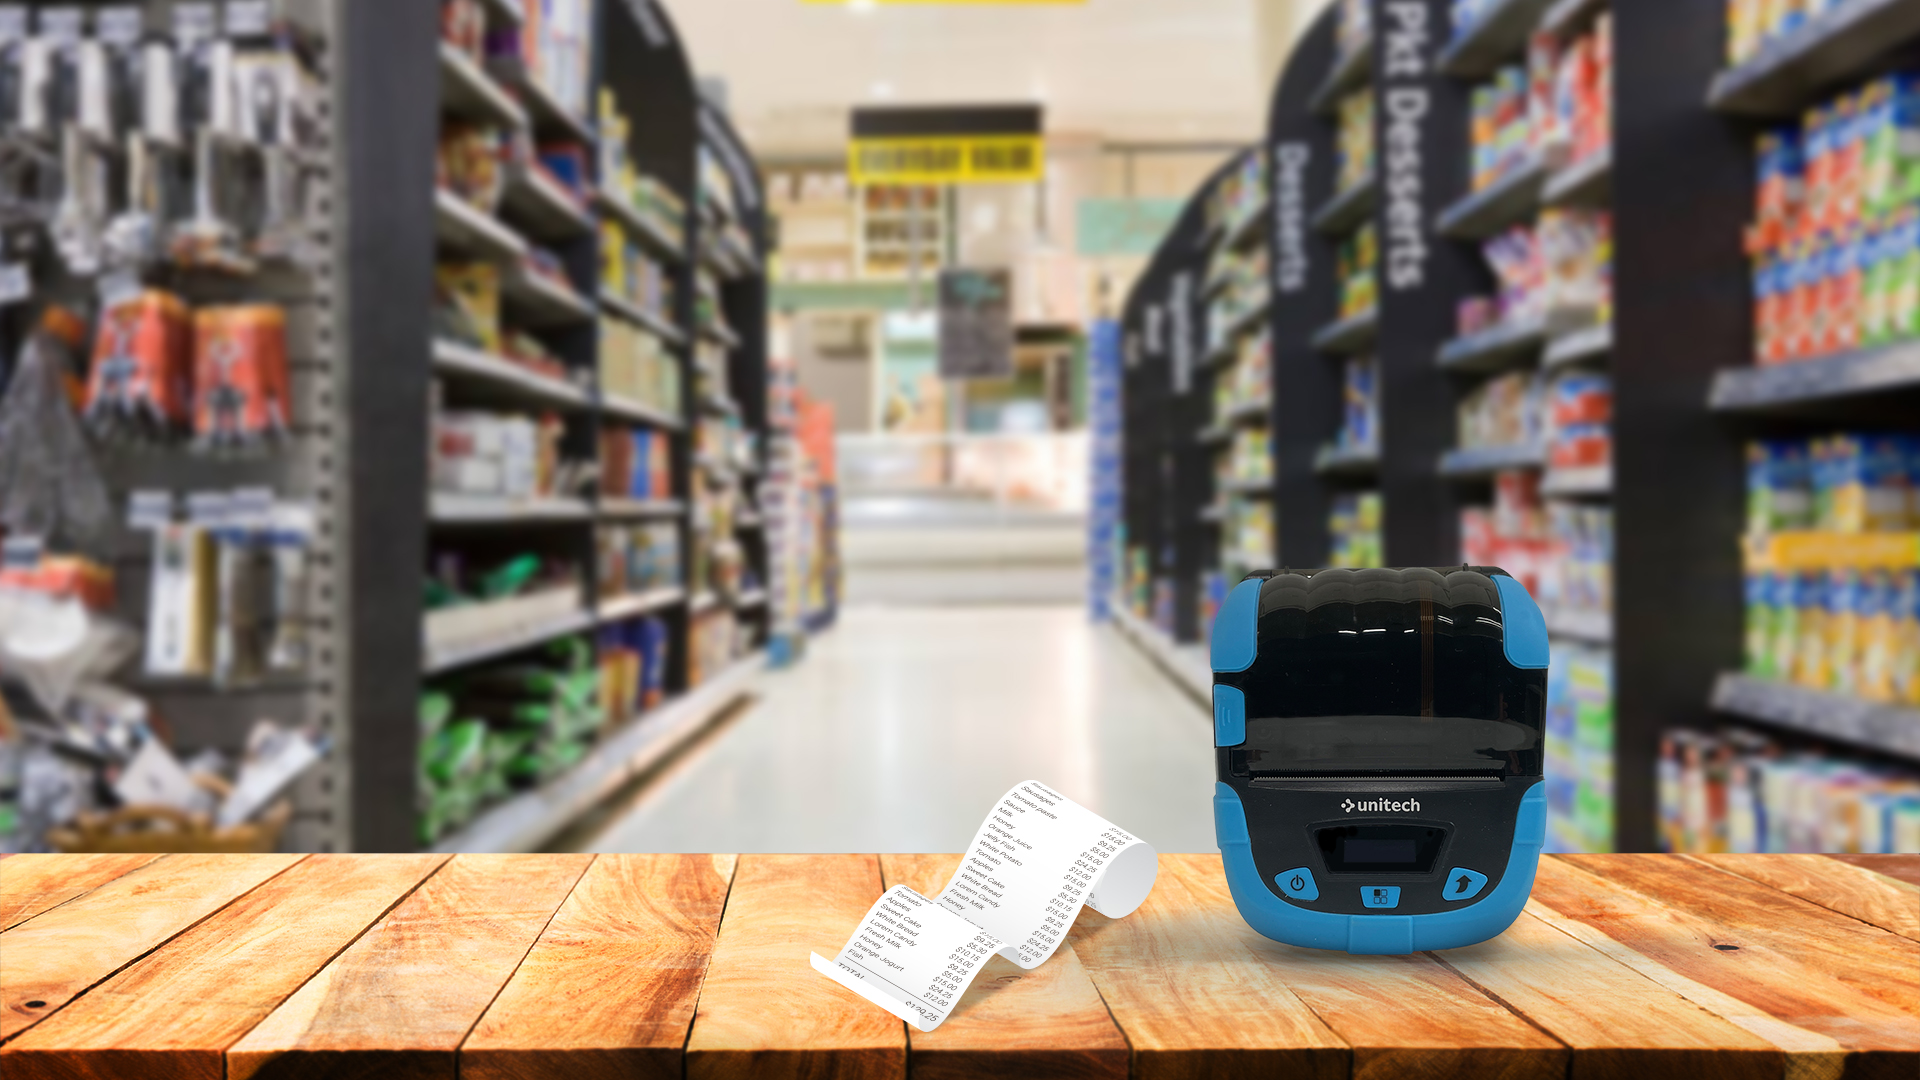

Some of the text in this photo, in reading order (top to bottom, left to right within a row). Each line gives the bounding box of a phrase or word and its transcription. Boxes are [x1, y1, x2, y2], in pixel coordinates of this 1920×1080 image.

[1385, 2, 1430, 289] Pkt Desserts
[1277, 141, 1310, 291] Desserts
[1011, 791, 1037, 809] Tomato
[1098, 840, 1117, 852] $9.25
[1021, 785, 1055, 806] Sausages
[1358, 797, 1420, 812] unitech
[988, 823, 1092, 880] Orange Juice $12.00
[993, 815, 1097, 873] Honey $24.25
[998, 807, 1103, 865] Milk $15.00
[1003, 800, 1109, 858] Sauce $5.00
[969, 857, 993, 872] Apples
[1050, 898, 1073, 912] $10.15
[975, 848, 1001, 865] Tomato
[1058, 892, 1077, 903] $5.30
[980, 840, 1082, 896] White Potato $9.25
[983, 832, 1086, 888] Jelly Fish $15.00
[894, 889, 996, 949] Tomato $9.25
[949, 888, 1055, 944] Fresh Milk $15.00
[955, 881, 1060, 936] Lorem Candy $5.00
[961, 872, 1064, 928] White Bread $9.25
[965, 865, 1068, 920] Sweet Cake $15.00
[870, 918, 969, 976] Lorem Candy $9.25
[876, 911, 974, 969] White Bread $15.00
[880, 903, 981, 962] Sweet Cake $10.15
[886, 897, 987, 955] Apples $5.30
[942, 895, 1050, 952] Honey $24.25
[1019, 944, 1042, 959] $12.00
[847, 948, 948, 1007] Fish $12.00
[853, 941, 953, 999] Orange Jogurt $24.25
[859, 933, 958, 991] Honey $15.00
[865, 926, 963, 984] Fresh Milk $5.00
